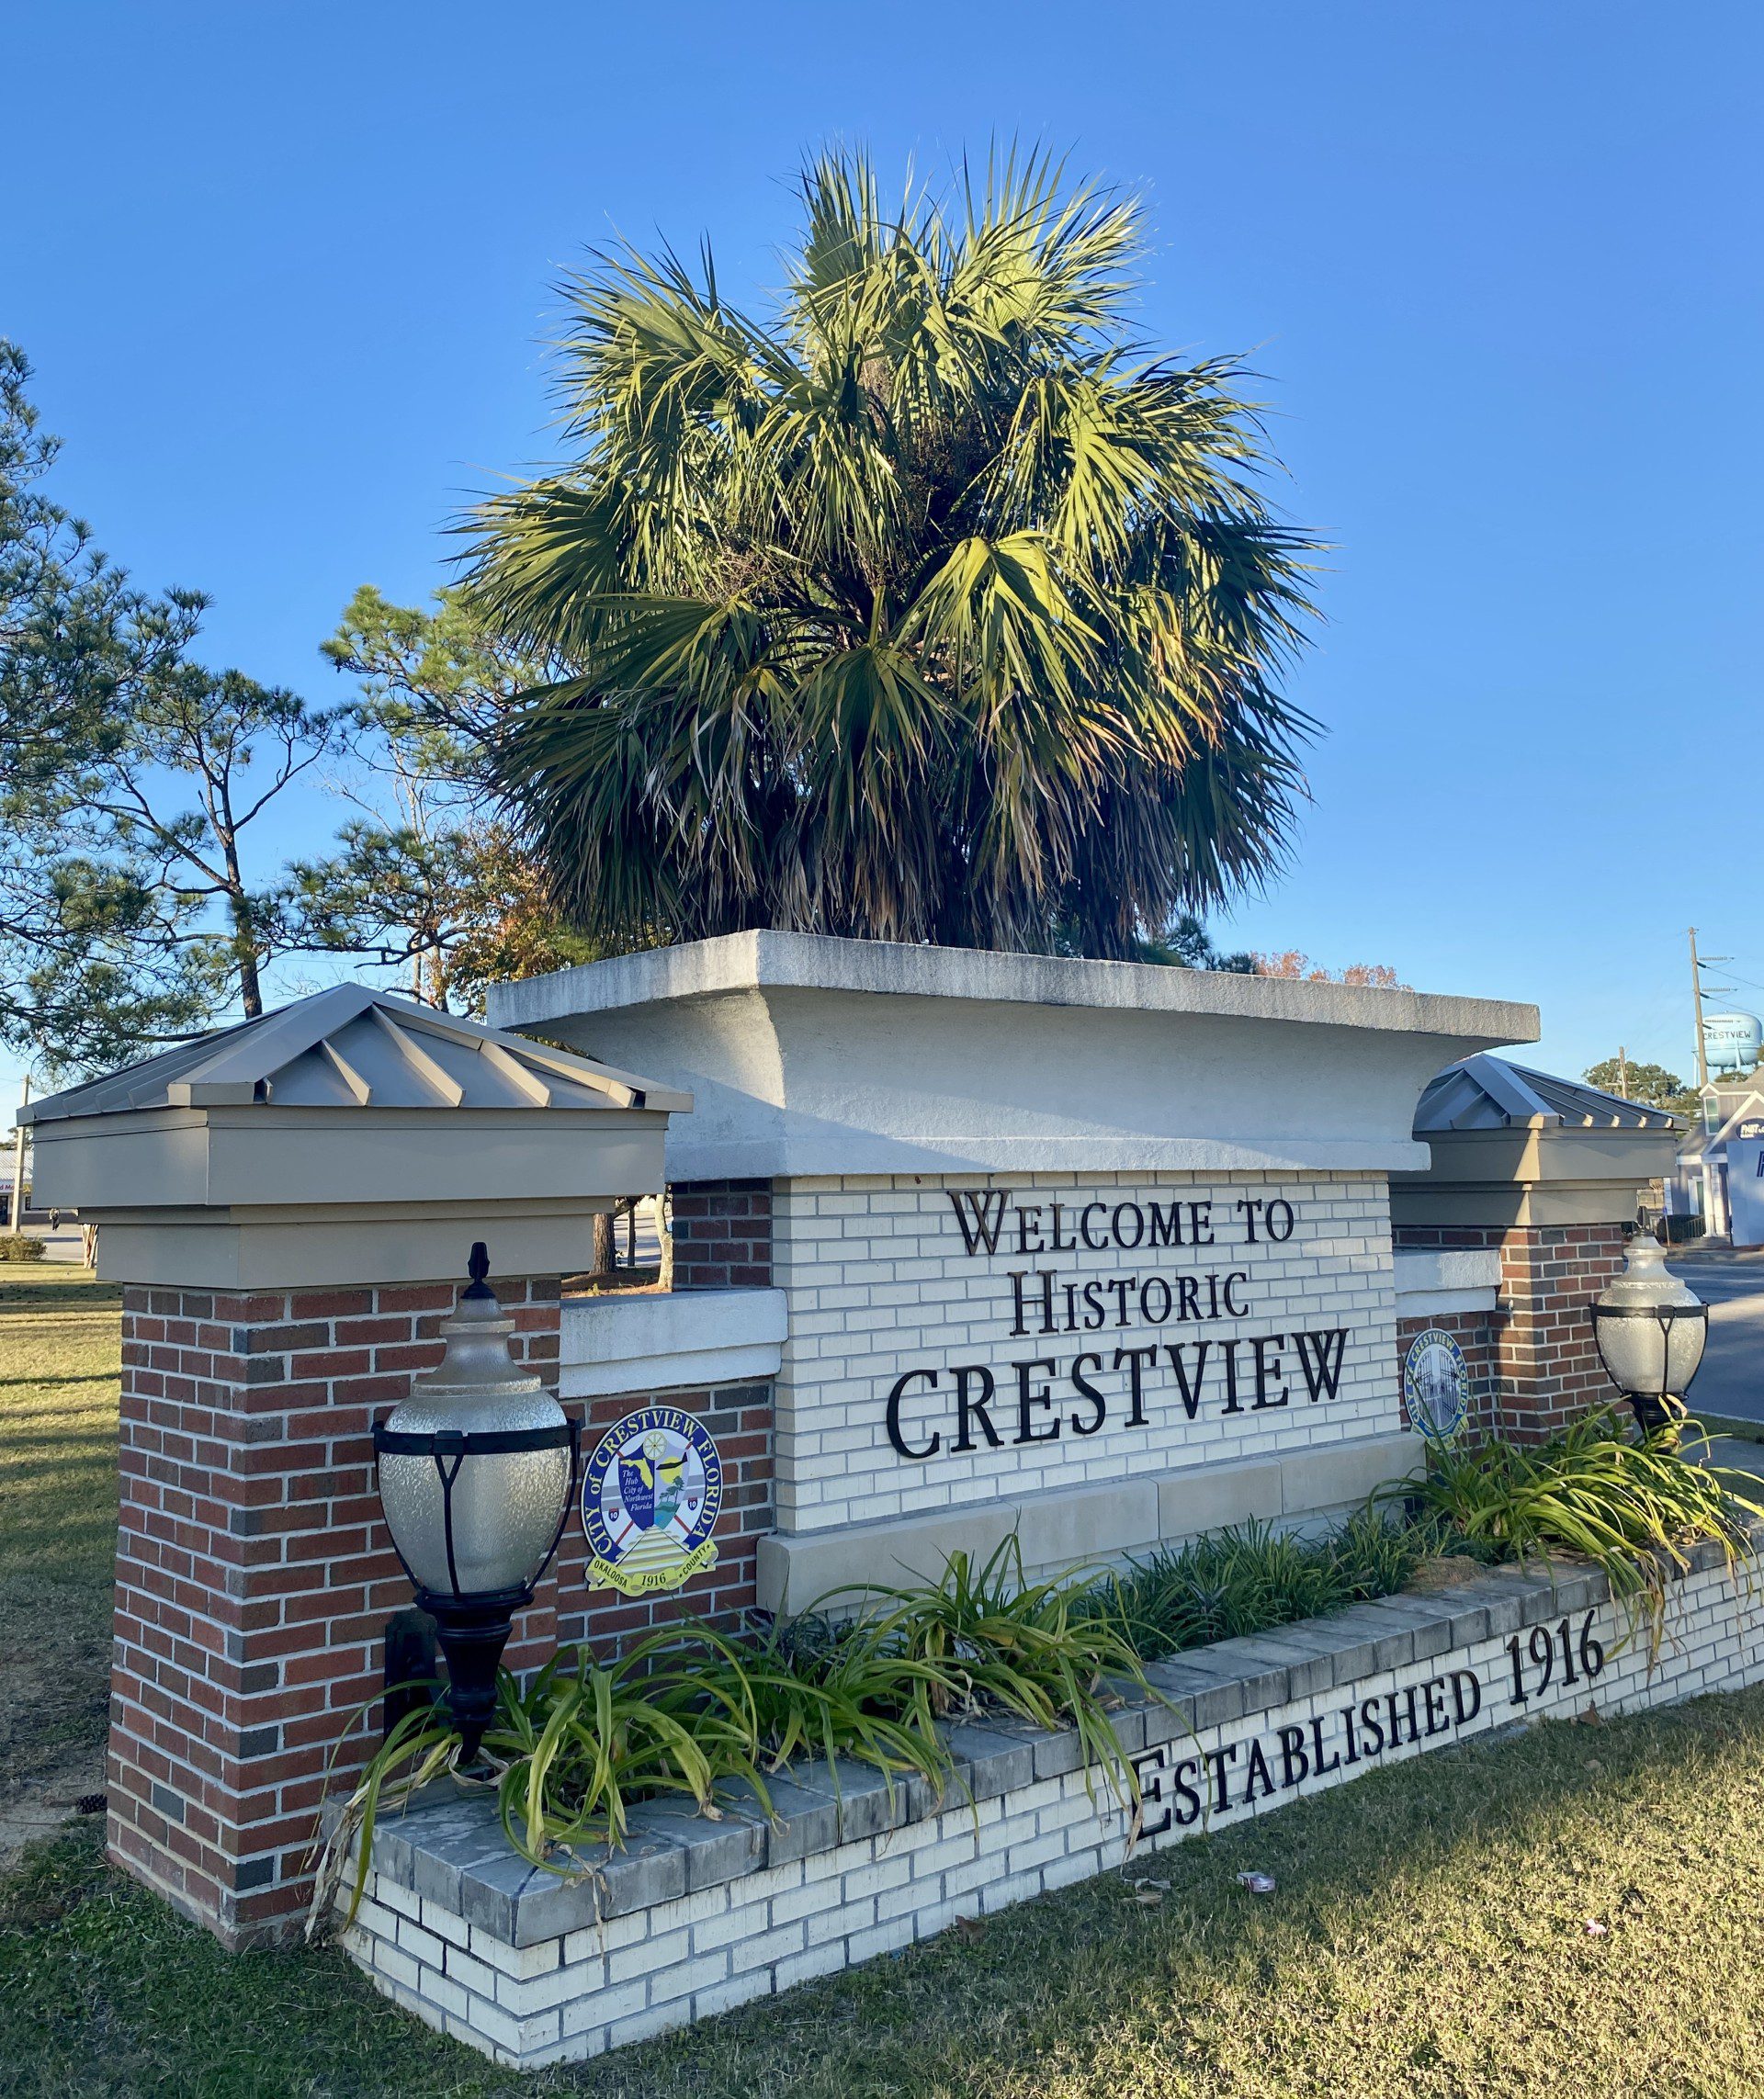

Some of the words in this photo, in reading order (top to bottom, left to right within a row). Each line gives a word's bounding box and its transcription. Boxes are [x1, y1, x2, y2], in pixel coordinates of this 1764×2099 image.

[1703, 1031, 1751, 1040] CRESTVIEW
[947, 1189, 1215, 1257] WELCOME
[1237, 1199, 1295, 1244] TO
[1007, 1269, 1250, 1337] HISTORIC
[886, 1328, 1351, 1460] CRESTVIEW
[1408, 1394, 1419, 1423] CITY
[1456, 1355, 1467, 1415] FLORIDA
[595, 1409, 700, 1468] CRESTVIEW,
[590, 1473, 603, 1495] of
[622, 1469, 634, 1478] The
[625, 1477, 639, 1486] Hub
[624, 1485, 637, 1495] City
[637, 1484, 644, 1494] of
[624, 1493, 654, 1503] Northwest
[692, 1437, 719, 1539] FLORIDA
[610, 1511, 617, 1519] 10
[630, 1502, 653, 1512] Florida
[689, 1500, 696, 1508] 10
[584, 1507, 613, 1554] CITY
[683, 1547, 707, 1574] COUNTY
[594, 1560, 628, 1588] OKALOOSA
[641, 1573, 666, 1586] 1916
[1126, 1670, 1481, 1842] ESTABLISHED
[1506, 1608, 1604, 1707] 1916
